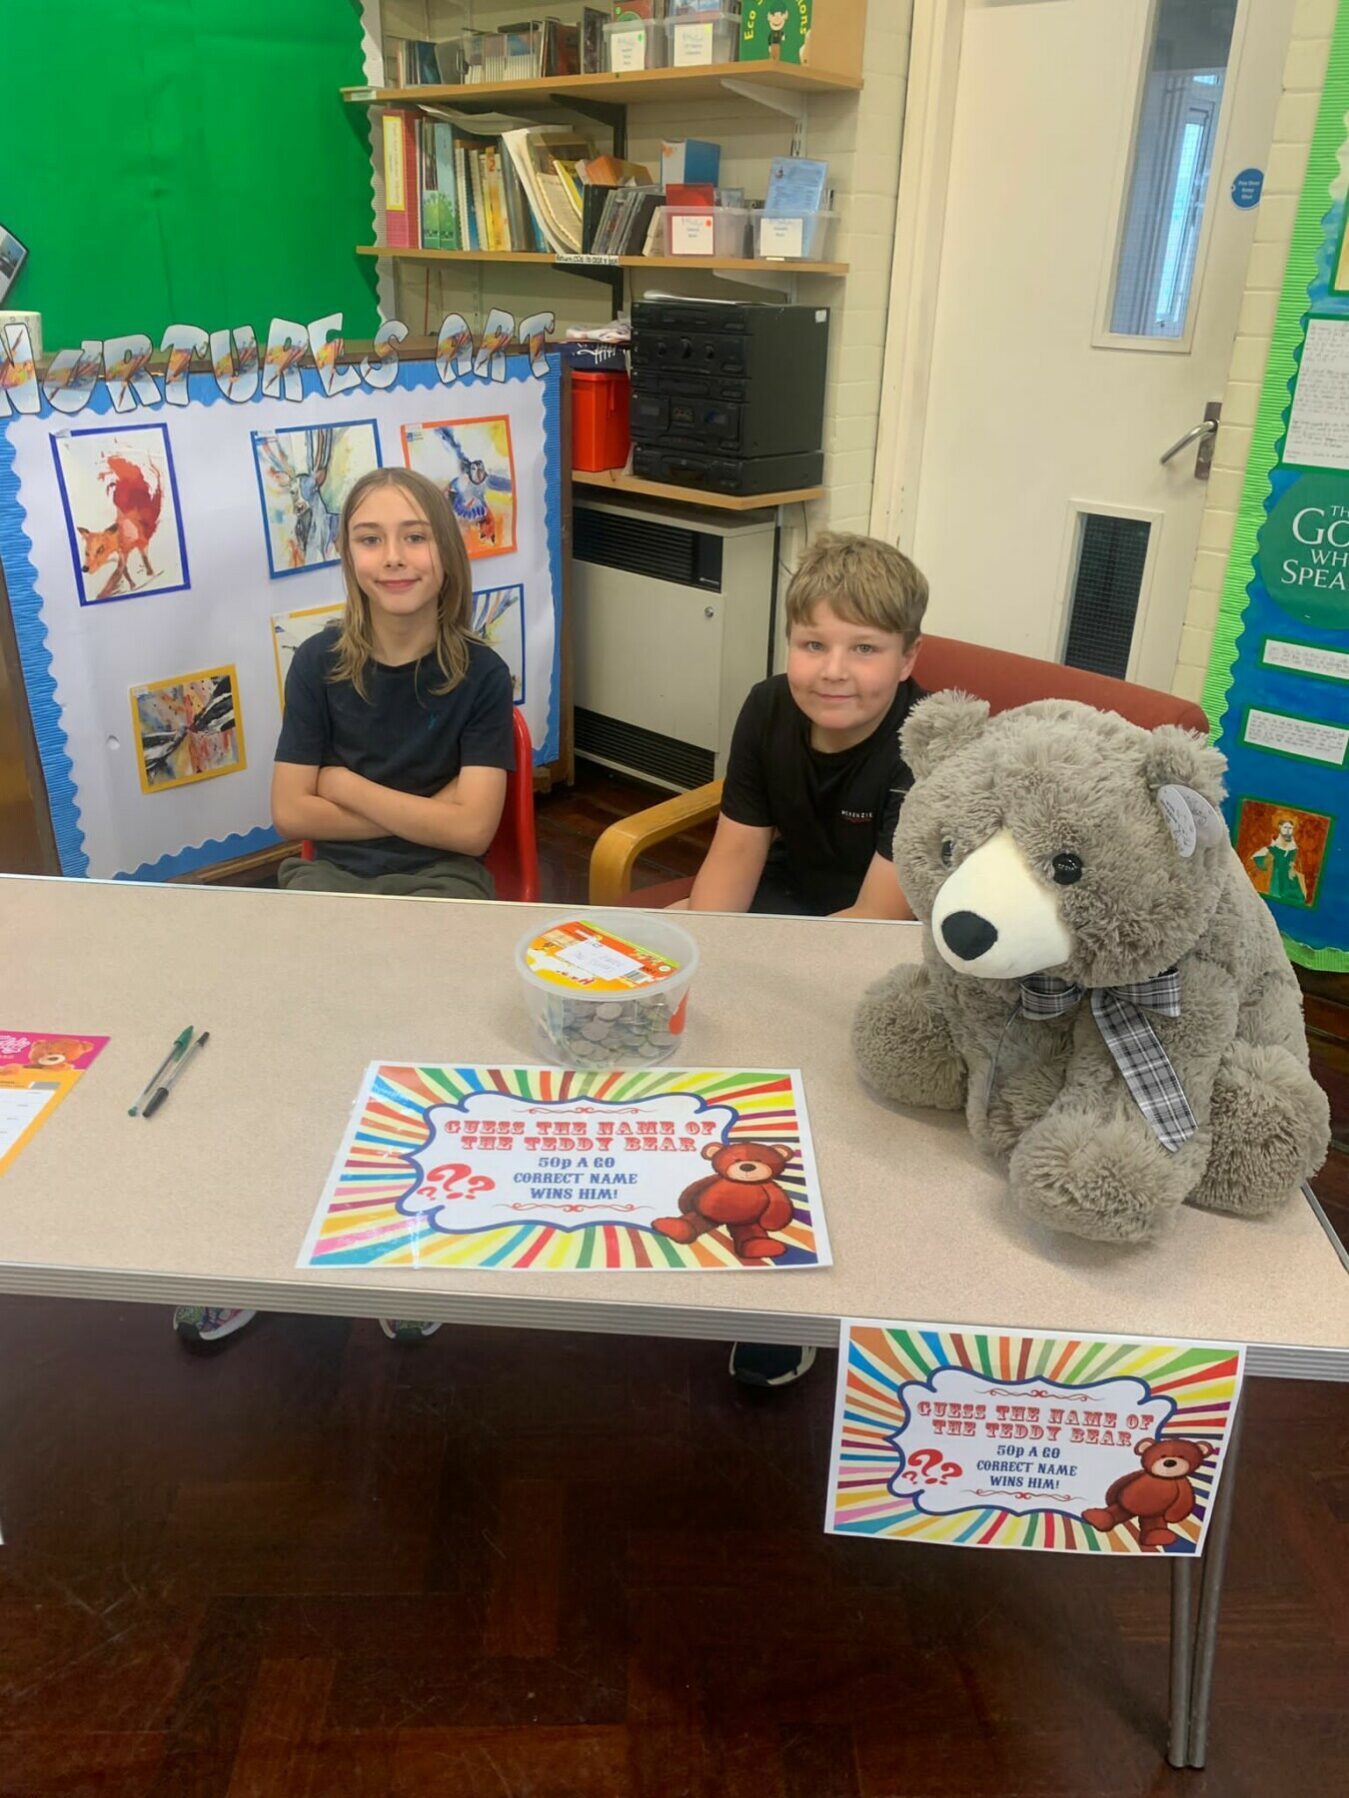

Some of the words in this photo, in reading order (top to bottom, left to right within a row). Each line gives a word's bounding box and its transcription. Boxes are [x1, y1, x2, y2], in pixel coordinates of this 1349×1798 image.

[435, 308, 556, 384] ART
[444, 1120, 526, 1136] GUESS
[536, 1120, 588, 1136] THE
[597, 1121, 676, 1136] NAME
[685, 1121, 717, 1136] OF
[461, 1136, 517, 1151] THE
[524, 1136, 613, 1152] TEDDY
[625, 1137, 698, 1152] BEAR
[538, 1157, 572, 1171] 50p
[576, 1157, 589, 1169] A
[594, 1157, 616, 1169] GO
[513, 1172, 585, 1185] CORRECT
[590, 1172, 639, 1185] NAME
[530, 1187, 573, 1200] WINS
[579, 1188, 619, 1200] HIM!
[917, 1401, 987, 1419] GUESS
[996, 1404, 1041, 1422] THE
[1048, 1408, 1117, 1428] NAME
[1126, 1414, 1155, 1430] OF
[932, 1419, 977, 1437] THE
[985, 1422, 1059, 1441] TEDDY
[1069, 1427, 1132, 1447] BEAR
[996, 1444, 1025, 1459] 50p
[1028, 1446, 1040, 1457] A
[1042, 1446, 1061, 1459] GO
[976, 1460, 1034, 1473] CORRECT
[1037, 1463, 1078, 1476] NAME
[990, 1475, 1024, 1488] WINS
[1027, 1476, 1060, 1490] HIM!
